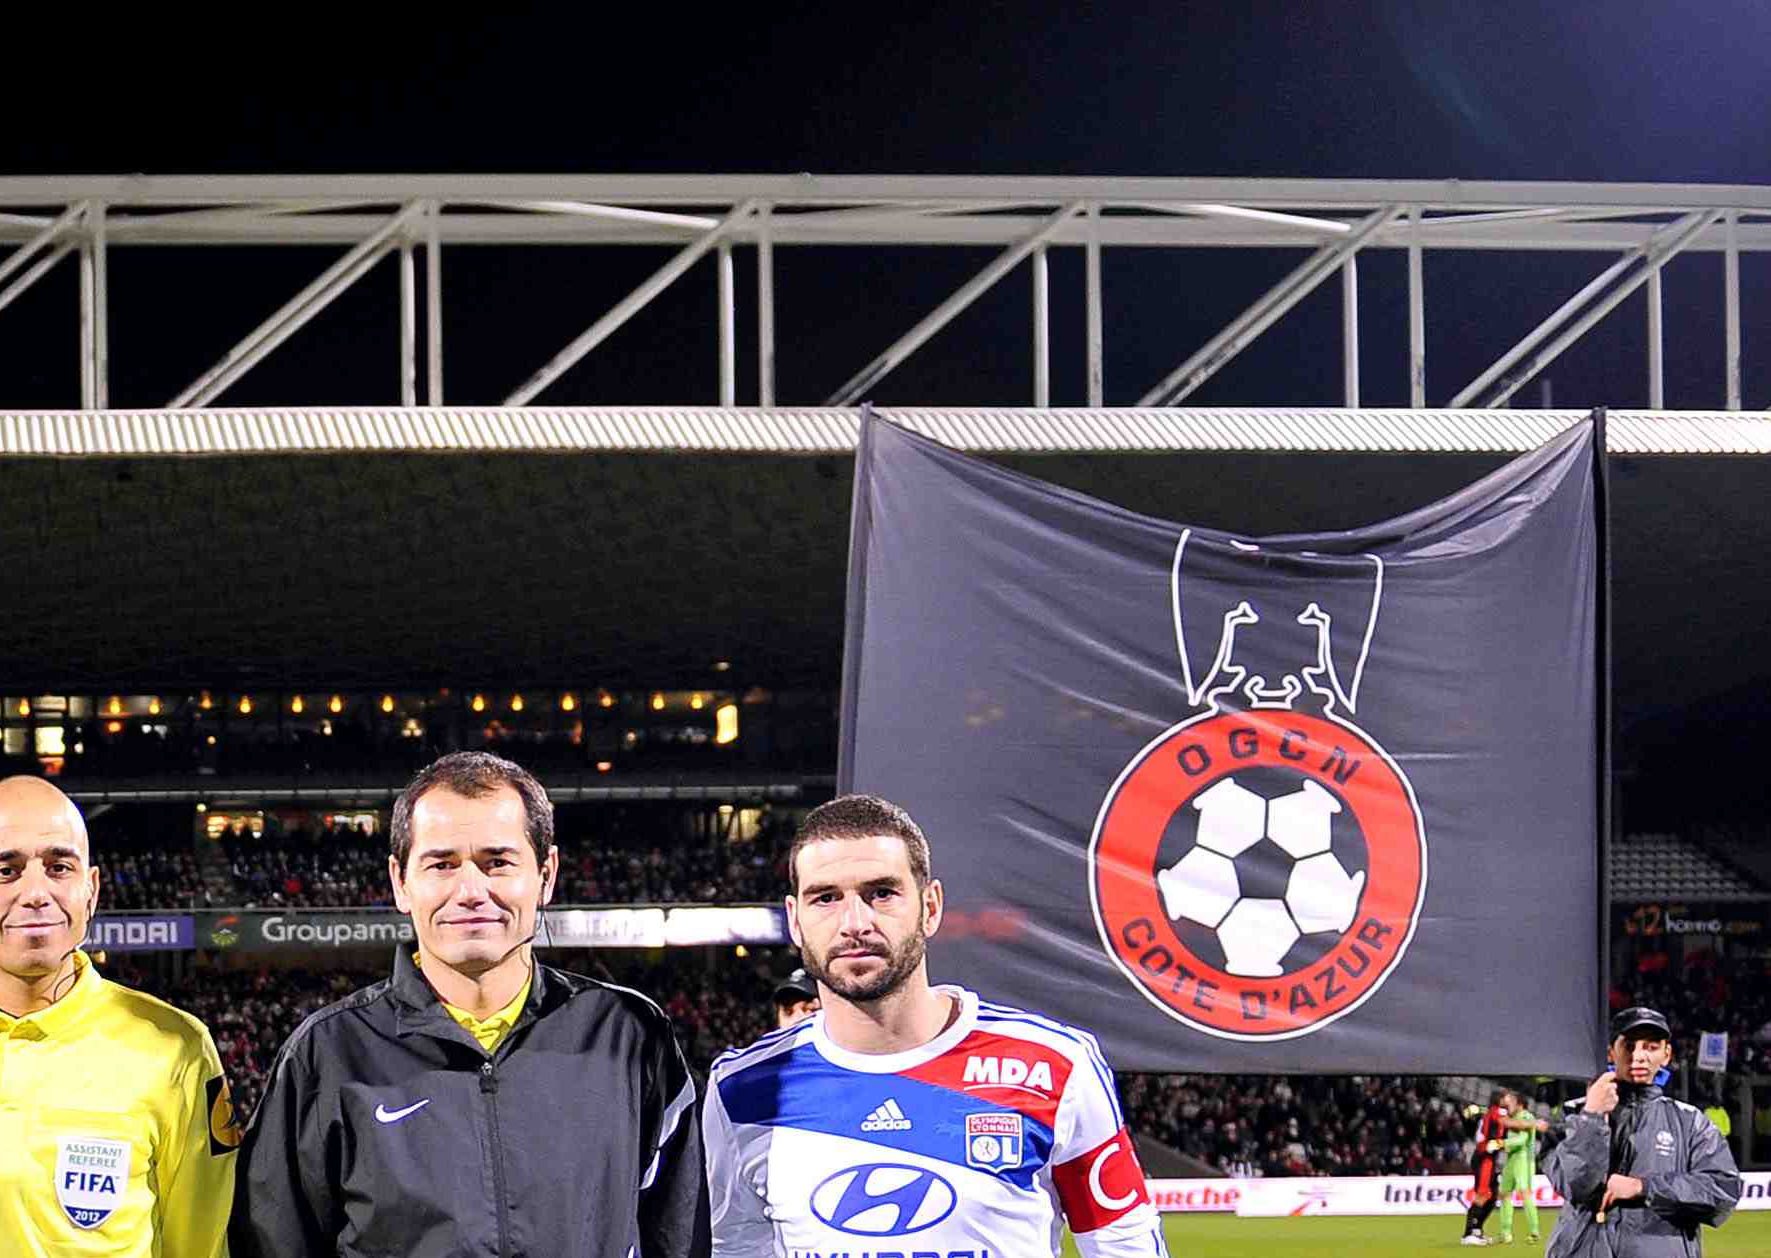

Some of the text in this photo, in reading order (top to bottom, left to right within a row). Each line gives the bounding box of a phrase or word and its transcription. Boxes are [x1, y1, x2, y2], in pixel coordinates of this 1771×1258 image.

[1176, 727, 1360, 786] OGCN
[261, 917, 414, 946] Groupama
[1239, 918, 1392, 1020] D'AZUR
[963, 1056, 1053, 1092] MDA
[861, 1118, 912, 1132] adidas
[66, 1143, 123, 1157] ASSISTANT
[68, 1154, 117, 1168] REFEREE
[64, 1171, 116, 1194] FIFA
[1089, 1142, 1138, 1210] C
